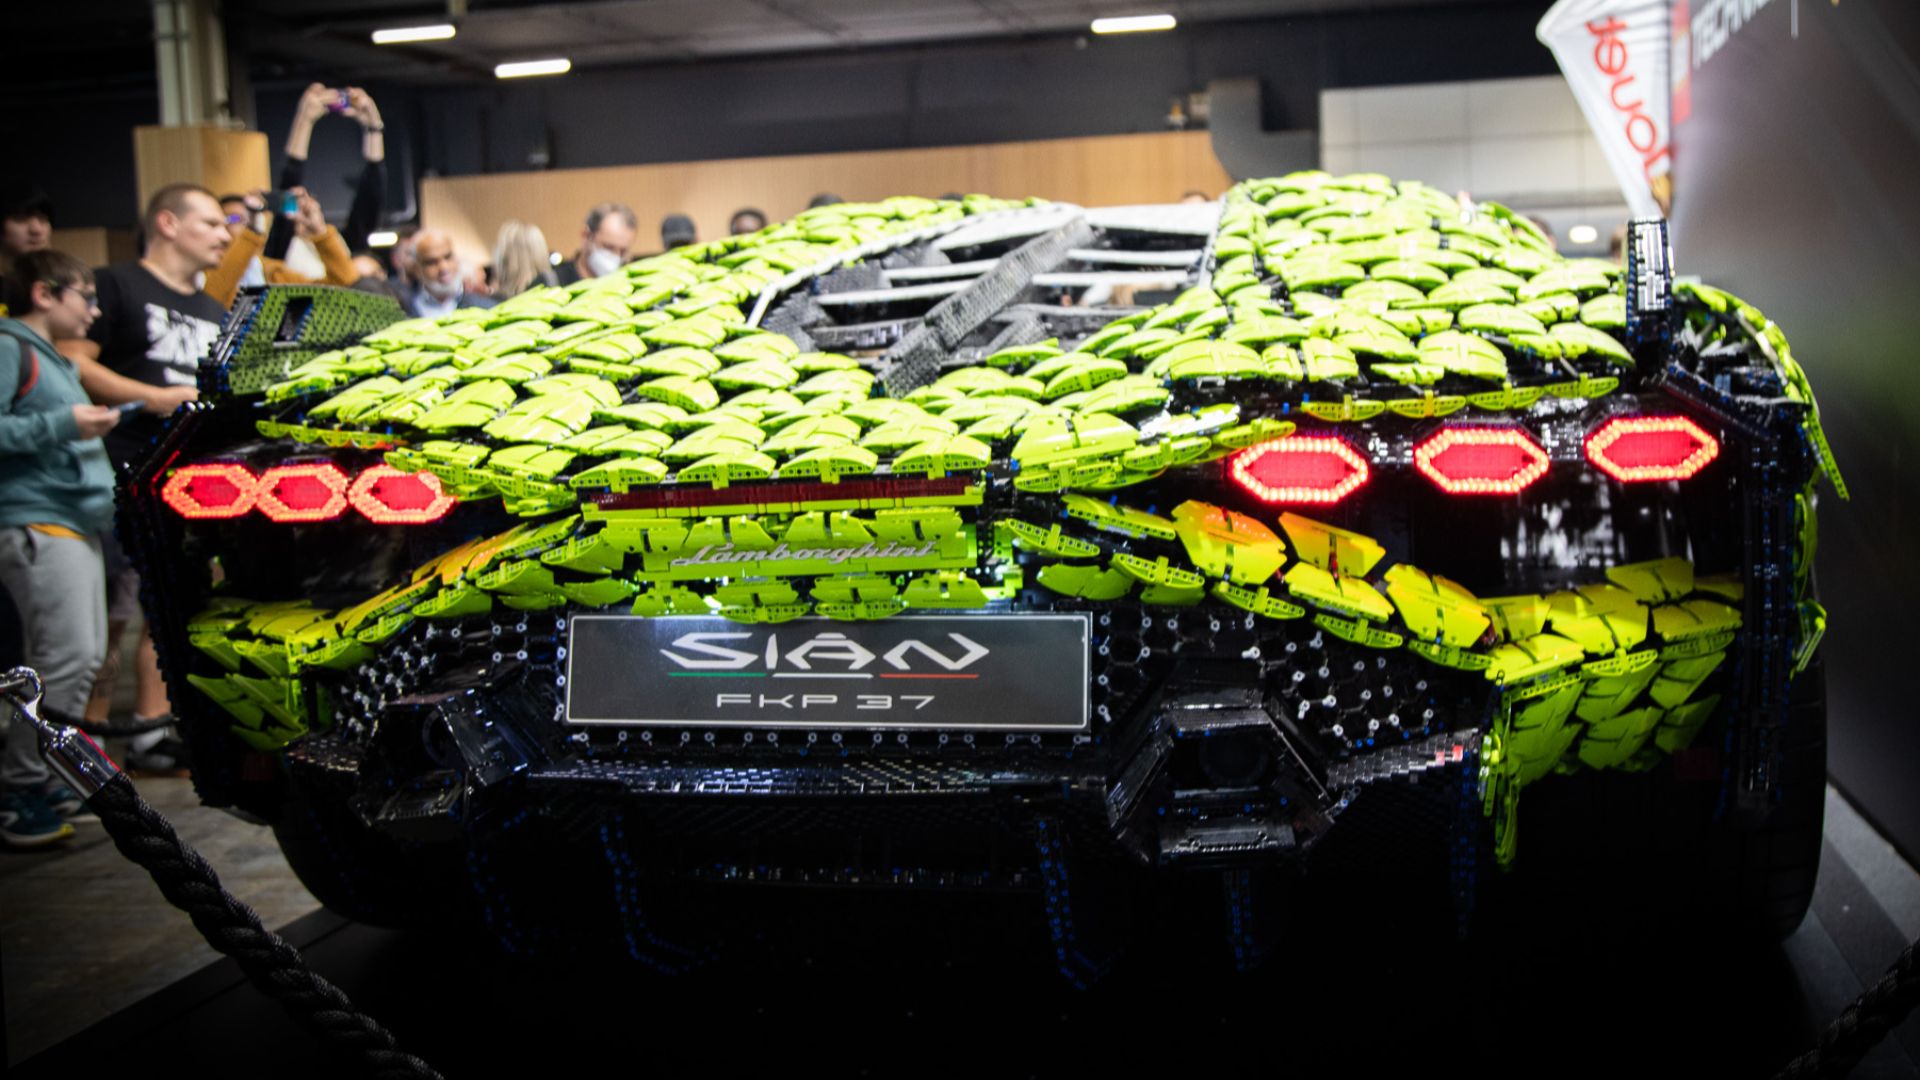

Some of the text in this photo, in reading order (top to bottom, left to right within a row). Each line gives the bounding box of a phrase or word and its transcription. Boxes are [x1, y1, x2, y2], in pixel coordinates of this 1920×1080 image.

[1691, 0, 1770, 70] TECH
[670, 540, 937, 566] Lamborghini
[716, 693, 936, 710] FKP 37
